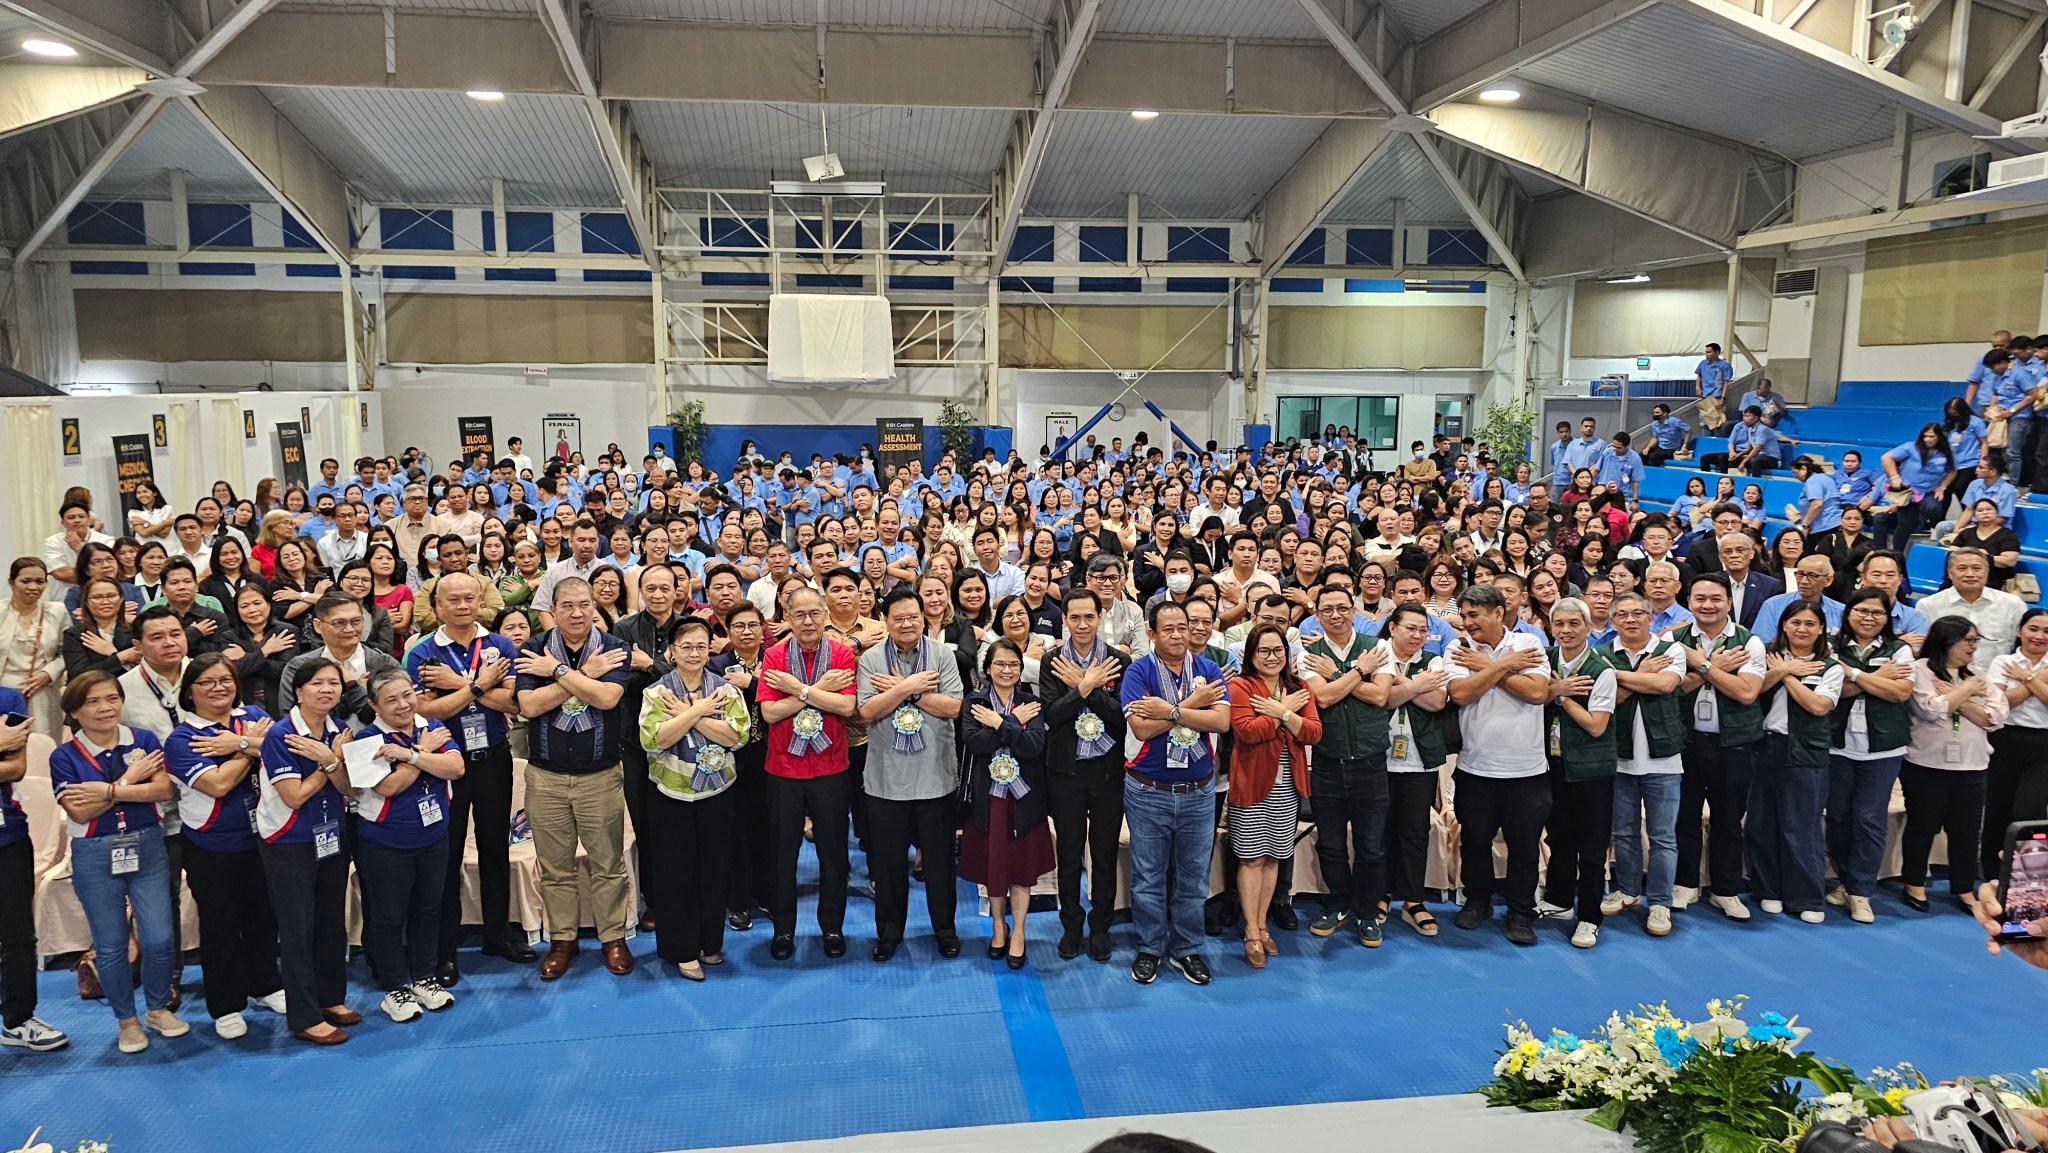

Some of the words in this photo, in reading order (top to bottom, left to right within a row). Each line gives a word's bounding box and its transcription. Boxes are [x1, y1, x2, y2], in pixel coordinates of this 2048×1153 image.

[246, 415, 255, 437] 4
[303, 414, 309, 433] 1
[65, 424, 79, 454] 2
[155, 420, 166, 446] 3
[465, 434, 488, 445] BLOOD
[884, 433, 916, 443] HEALTH
[284, 446, 300, 463] ECG
[878, 443, 922, 452] ASSESSMENT
[118, 461, 149, 477] MEDICAL
